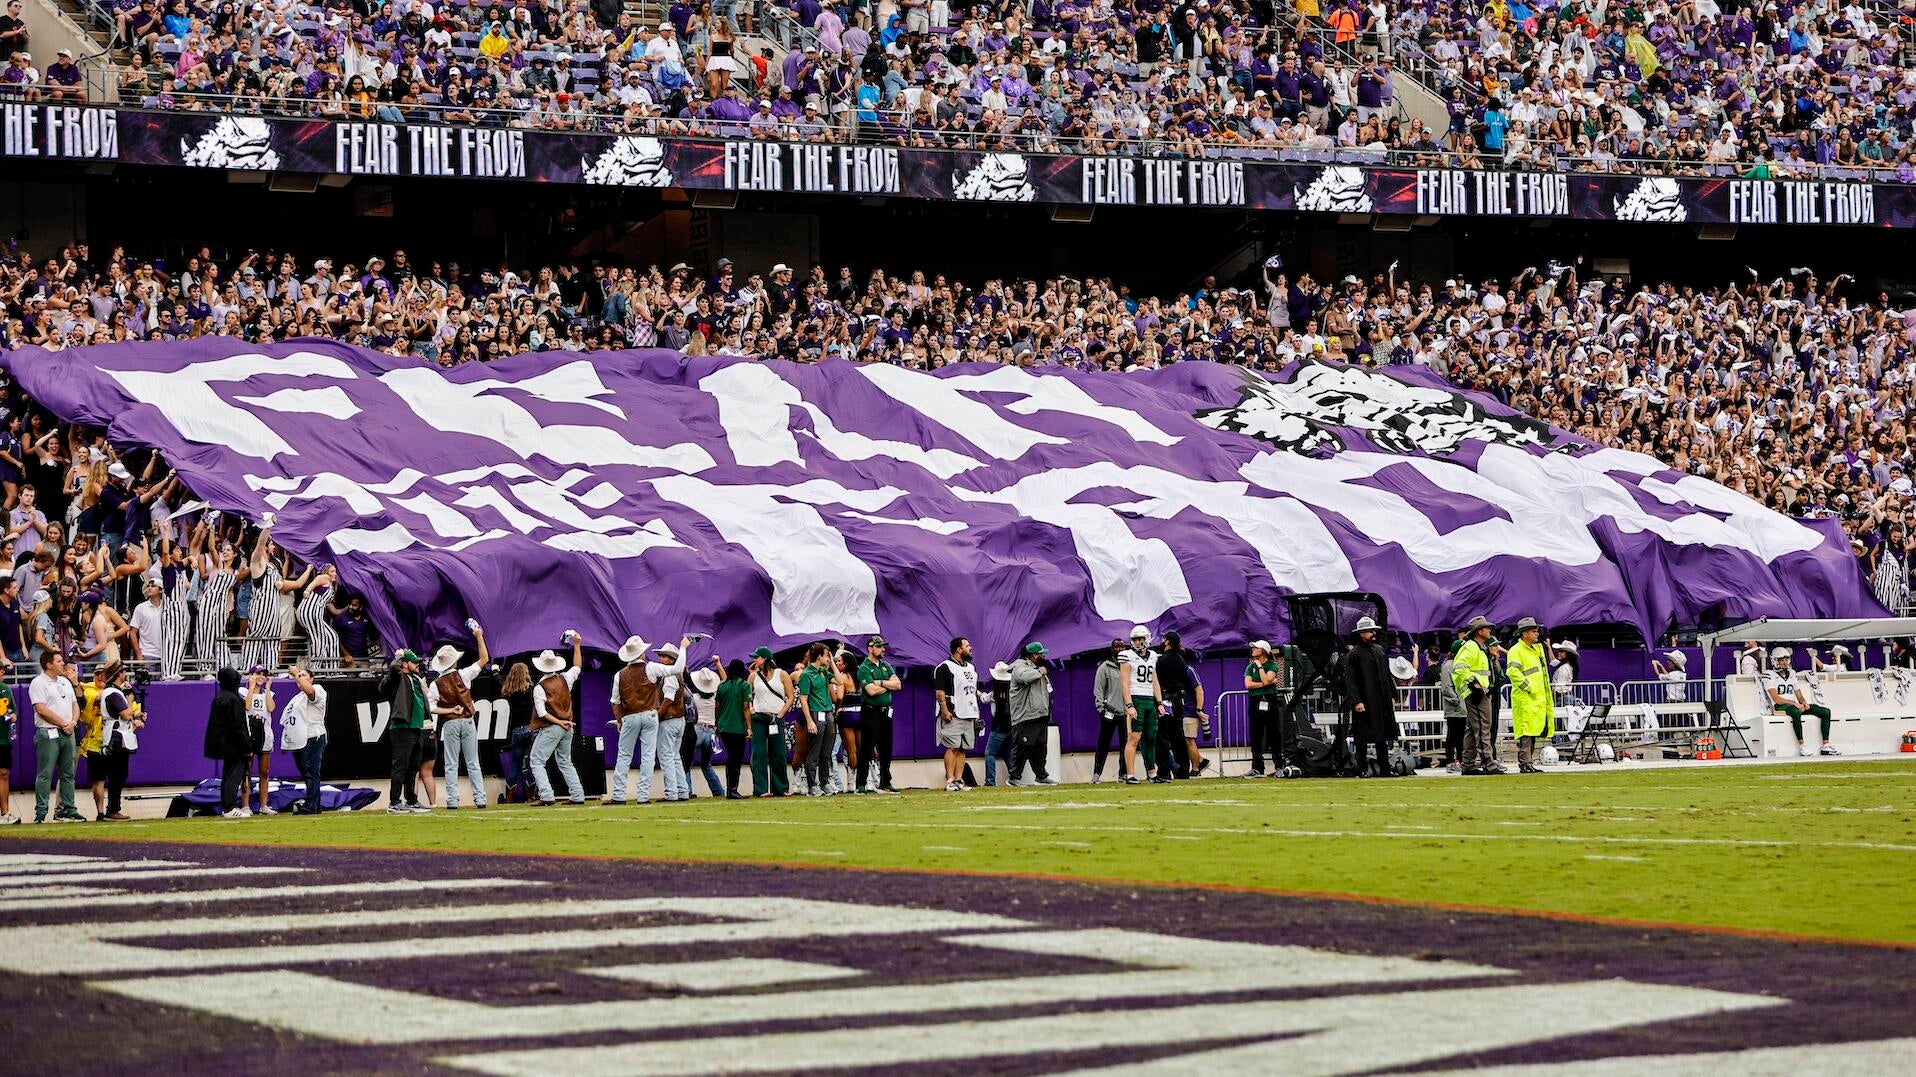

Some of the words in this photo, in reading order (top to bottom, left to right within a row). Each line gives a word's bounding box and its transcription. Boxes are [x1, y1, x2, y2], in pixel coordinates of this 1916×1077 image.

[0, 103, 39, 156] HE
[47, 106, 119, 158] FROG
[336, 122, 398, 174] FEAR
[407, 126, 455, 175] THE
[461, 129, 526, 177] FROG
[724, 142, 782, 190] FEAR
[790, 144, 834, 191] THE
[840, 146, 900, 193] FROG
[1082, 157, 1136, 204] FEAR
[1142, 159, 1184, 204] THE
[1188, 161, 1245, 205] FROG
[1417, 170, 1466, 215] FEAR
[1473, 171, 1511, 215] THE
[1516, 173, 1568, 215] FROG
[1729, 180, 1777, 223] FEAR
[1783, 181, 1820, 224] THE
[1825, 183, 1875, 224] FROG
